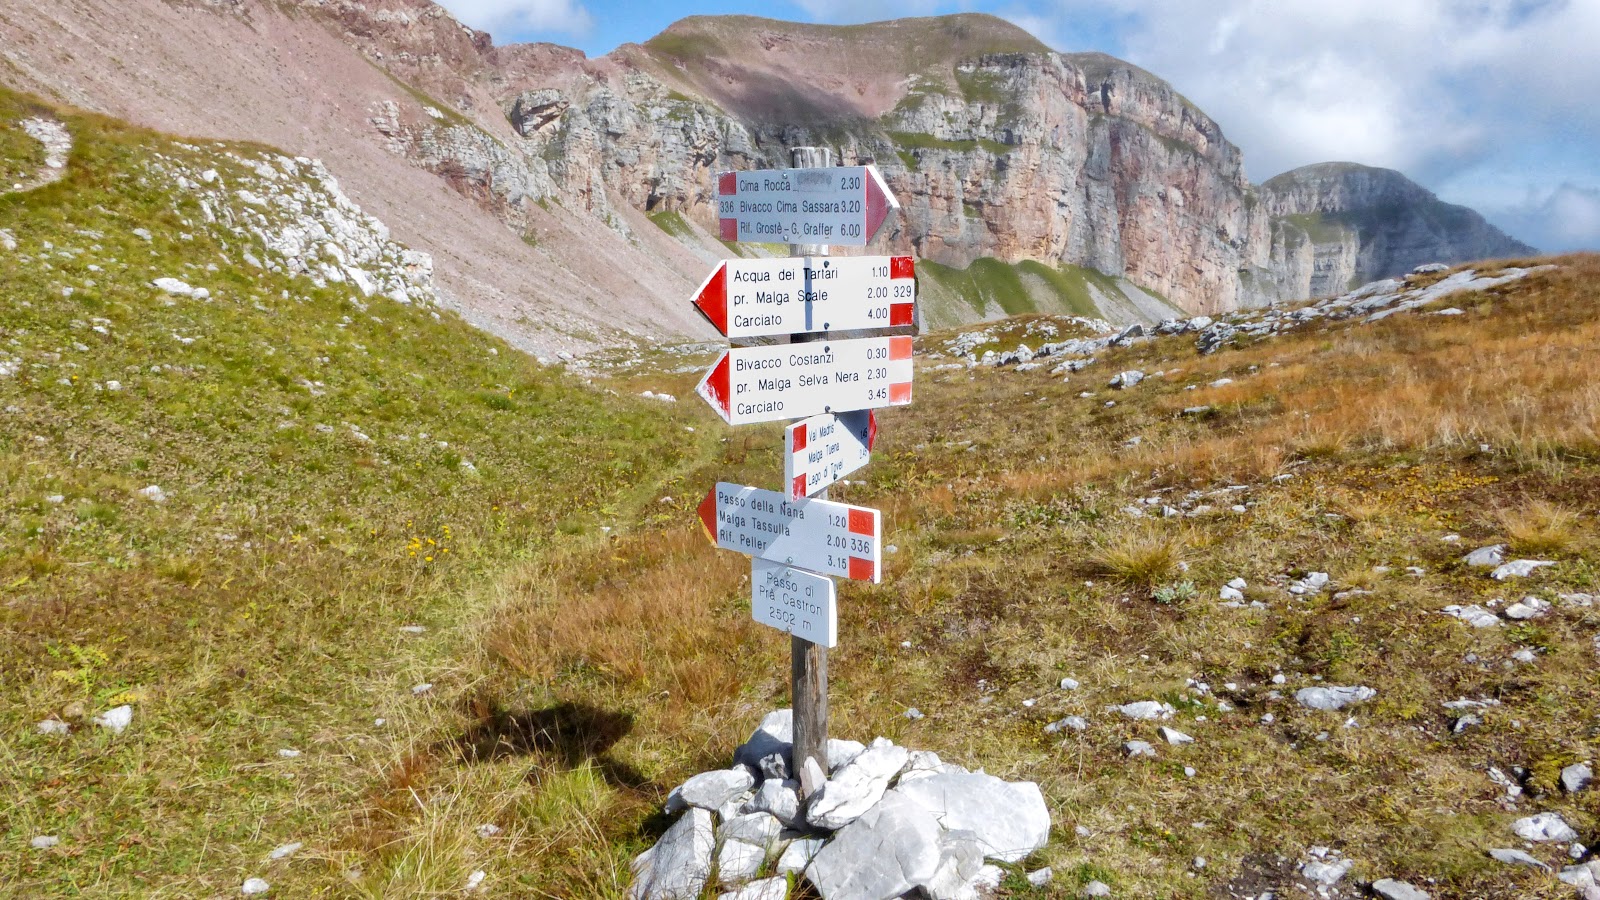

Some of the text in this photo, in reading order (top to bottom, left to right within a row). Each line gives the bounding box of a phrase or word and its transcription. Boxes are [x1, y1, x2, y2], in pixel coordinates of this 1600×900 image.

[740, 180, 759, 191] Cima
[764, 180, 790, 191] Rocca
[841, 178, 860, 190] 2.30
[720, 201, 860, 212] 336 Bivacco Cima Sassara 3.20
[741, 222, 752, 233] Rif.
[804, 223, 833, 235] Graffer
[841, 224, 860, 236] 6.00
[734, 266, 887, 283] Acqua dei Tartari 1.10
[734, 286, 911, 306] pr. Malga Scale 2.00 329
[734, 308, 887, 327] Carciato 4.00
[737, 348, 886, 371] Bivacco Costanzi 0.30
[737, 368, 886, 394] pr. Malga Selva Nera 2.30
[738, 388, 886, 415] Carciato 3.45
[809, 450, 822, 464] Malga
[826, 442, 839, 456] Tuena
[809, 471, 821, 486] Lago
[824, 466, 827, 477] di
[719, 492, 846, 528] Passo della Nana 1.20
[719, 511, 869, 553] Malga Tassulla 2.00 336
[720, 530, 846, 569] Rif. Peller 3.15
[767, 572, 813, 597] Passo di
[783, 593, 822, 615] Castron
[770, 607, 811, 631] 2502 m
